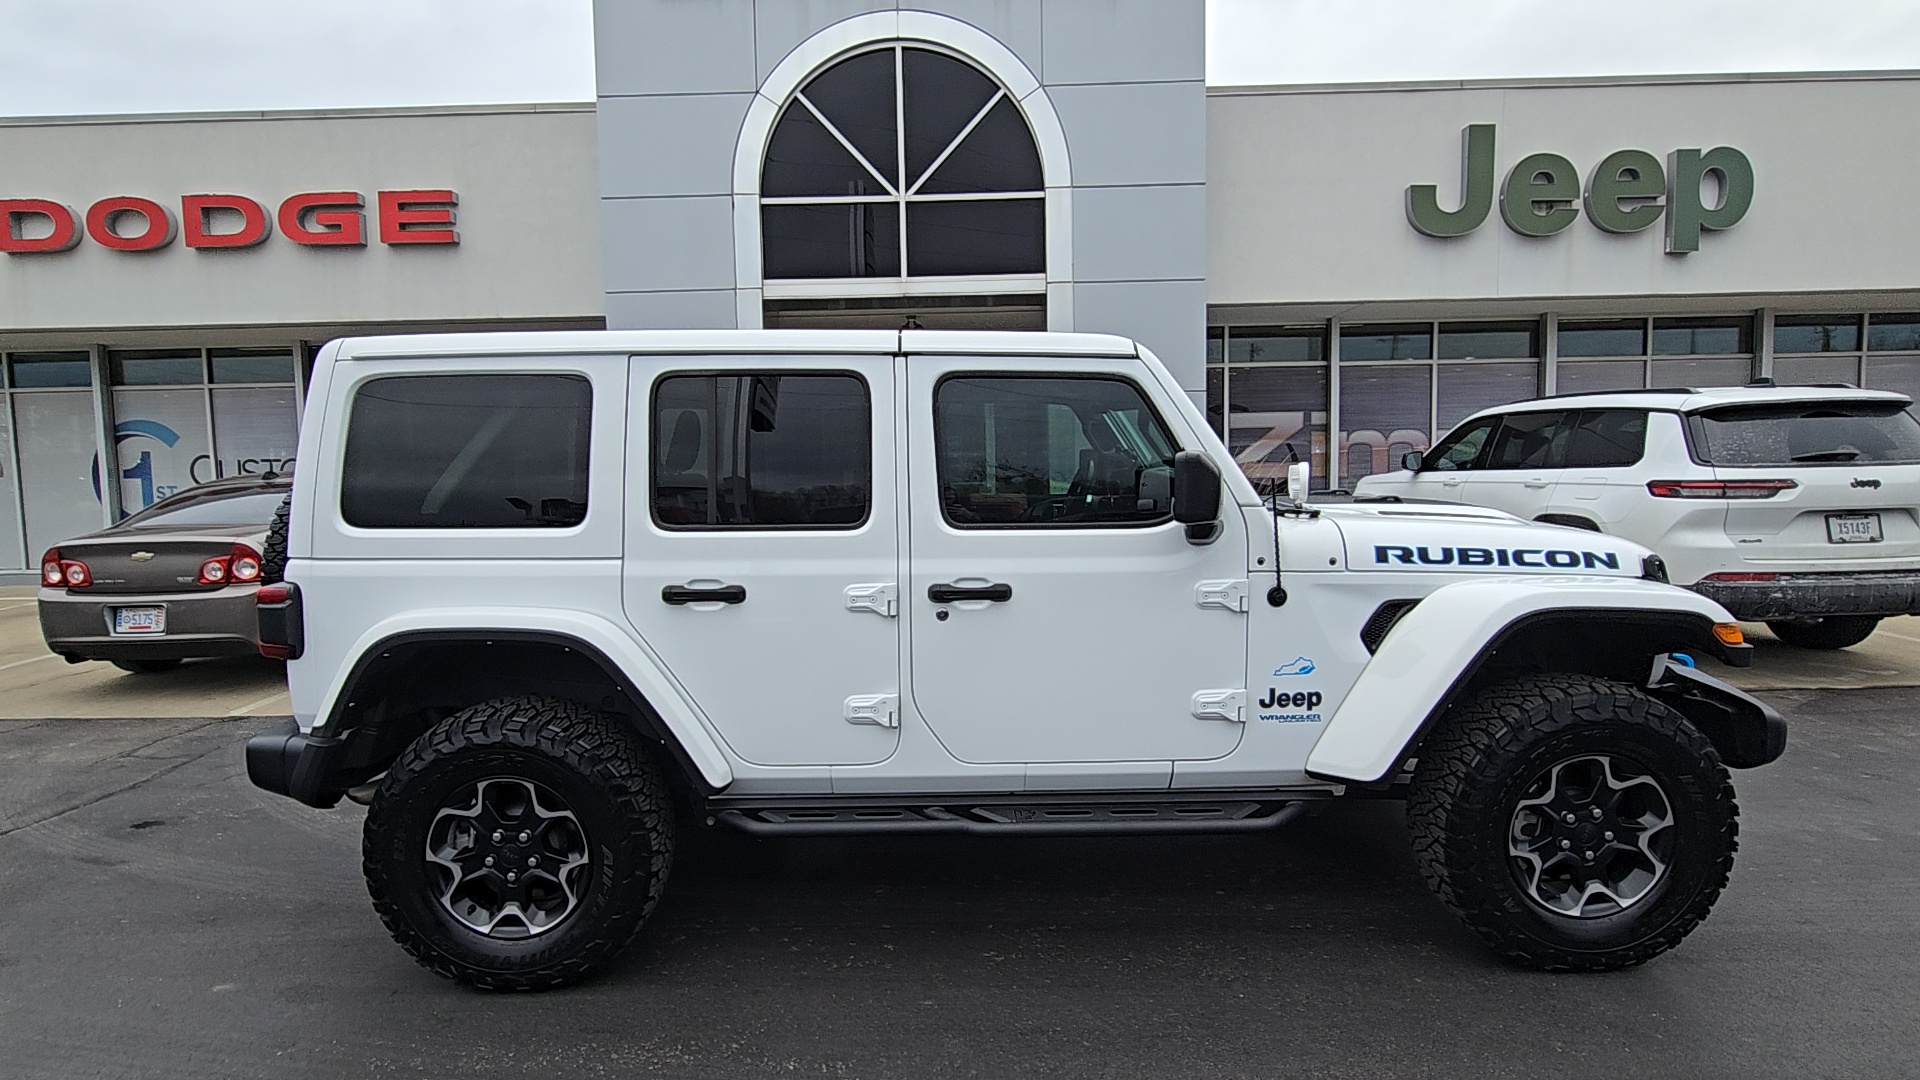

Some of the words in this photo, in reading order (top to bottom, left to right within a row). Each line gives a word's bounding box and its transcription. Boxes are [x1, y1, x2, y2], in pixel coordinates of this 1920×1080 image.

[1405, 123, 1754, 254] Jeep
[0, 189, 458, 252] DODGE
[1837, 521, 1871, 535] X5143F
[1373, 545, 1620, 570] RUBICON
[1259, 687, 1322, 711] Jeep
